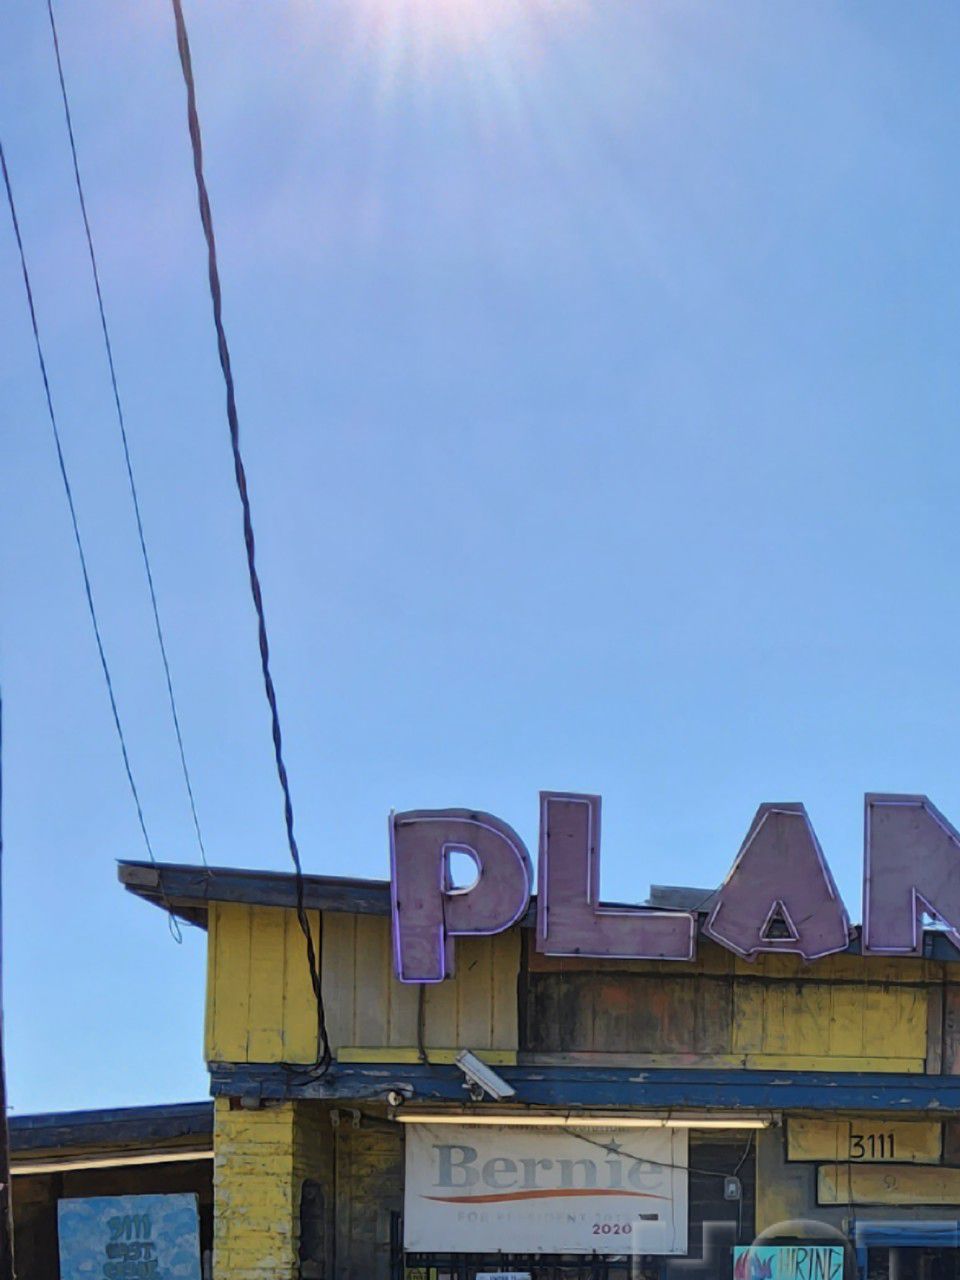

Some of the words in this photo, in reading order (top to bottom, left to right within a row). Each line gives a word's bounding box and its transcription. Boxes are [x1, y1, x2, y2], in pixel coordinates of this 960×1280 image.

[849, 1133, 894, 1159] 3111
[432, 1139, 664, 1189] Bernie
[592, 1224, 632, 1235] 2020
